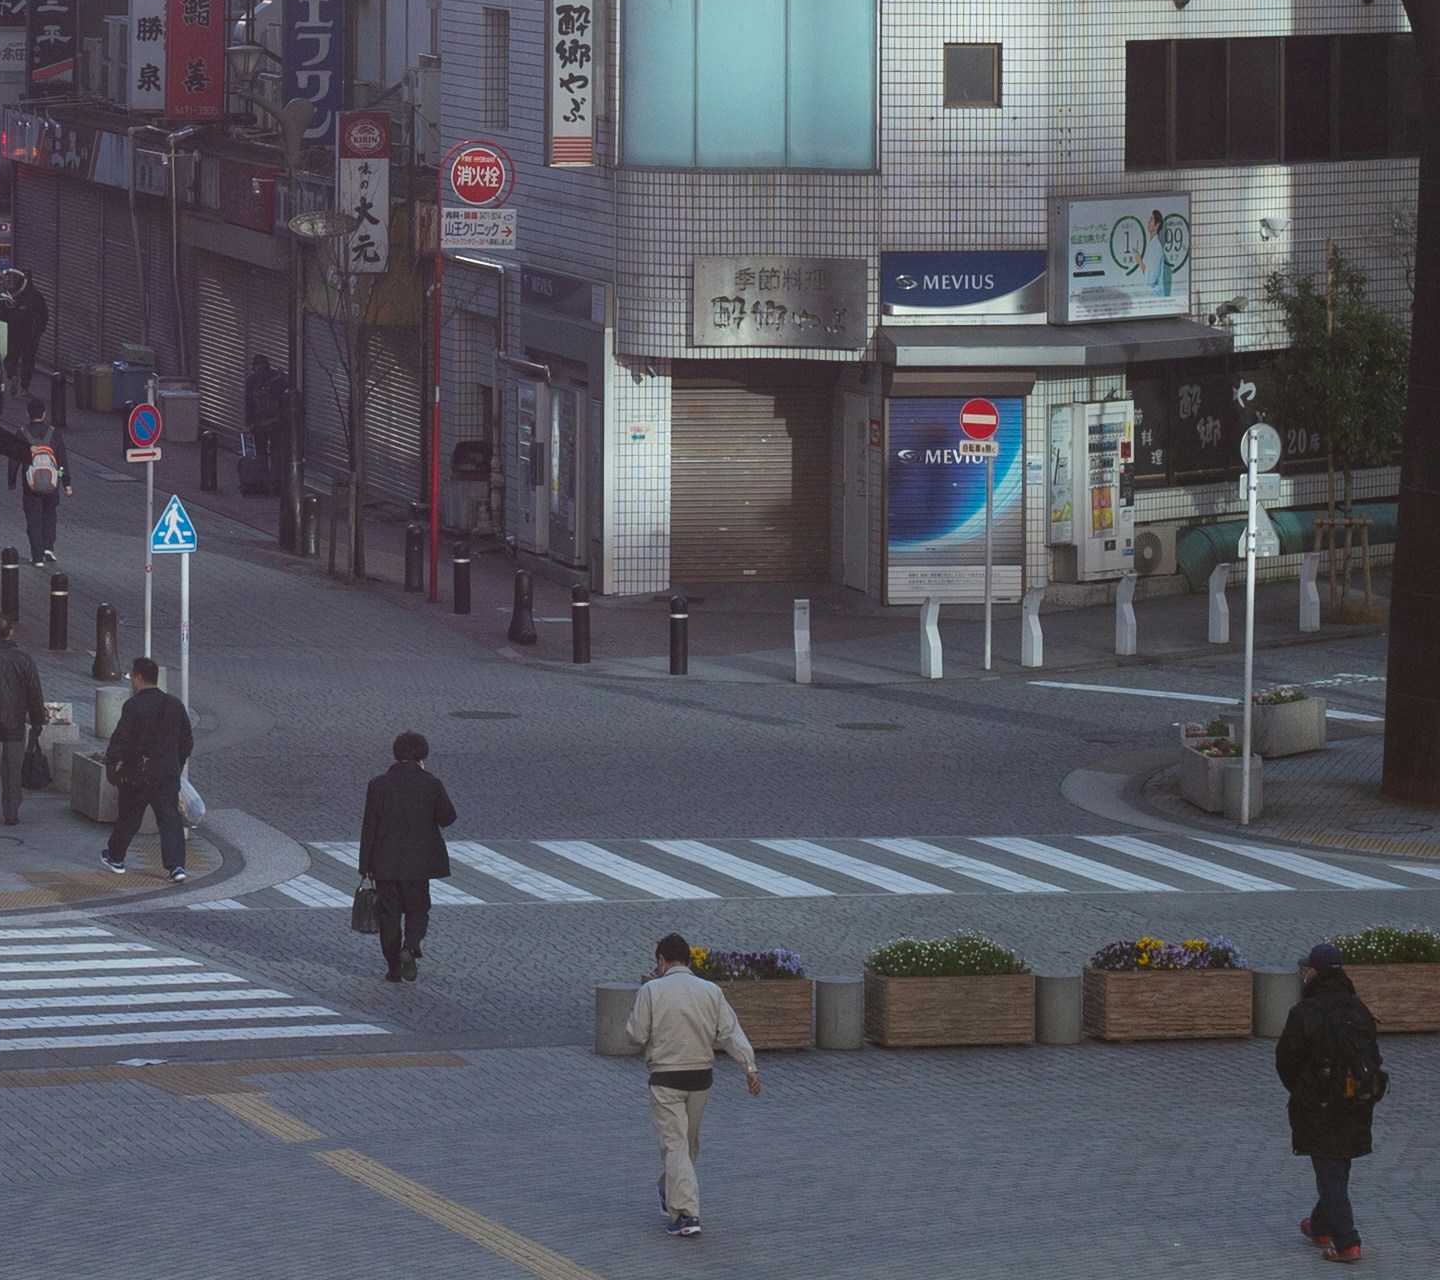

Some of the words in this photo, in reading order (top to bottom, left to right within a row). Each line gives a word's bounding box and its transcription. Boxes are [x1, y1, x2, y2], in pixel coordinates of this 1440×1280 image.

[353, 134, 379, 145] KIRIN
[455, 163, 501, 190] 消火栓
[444, 220, 500, 237] 山王クリニック
[923, 272, 995, 291] MEVIUS
